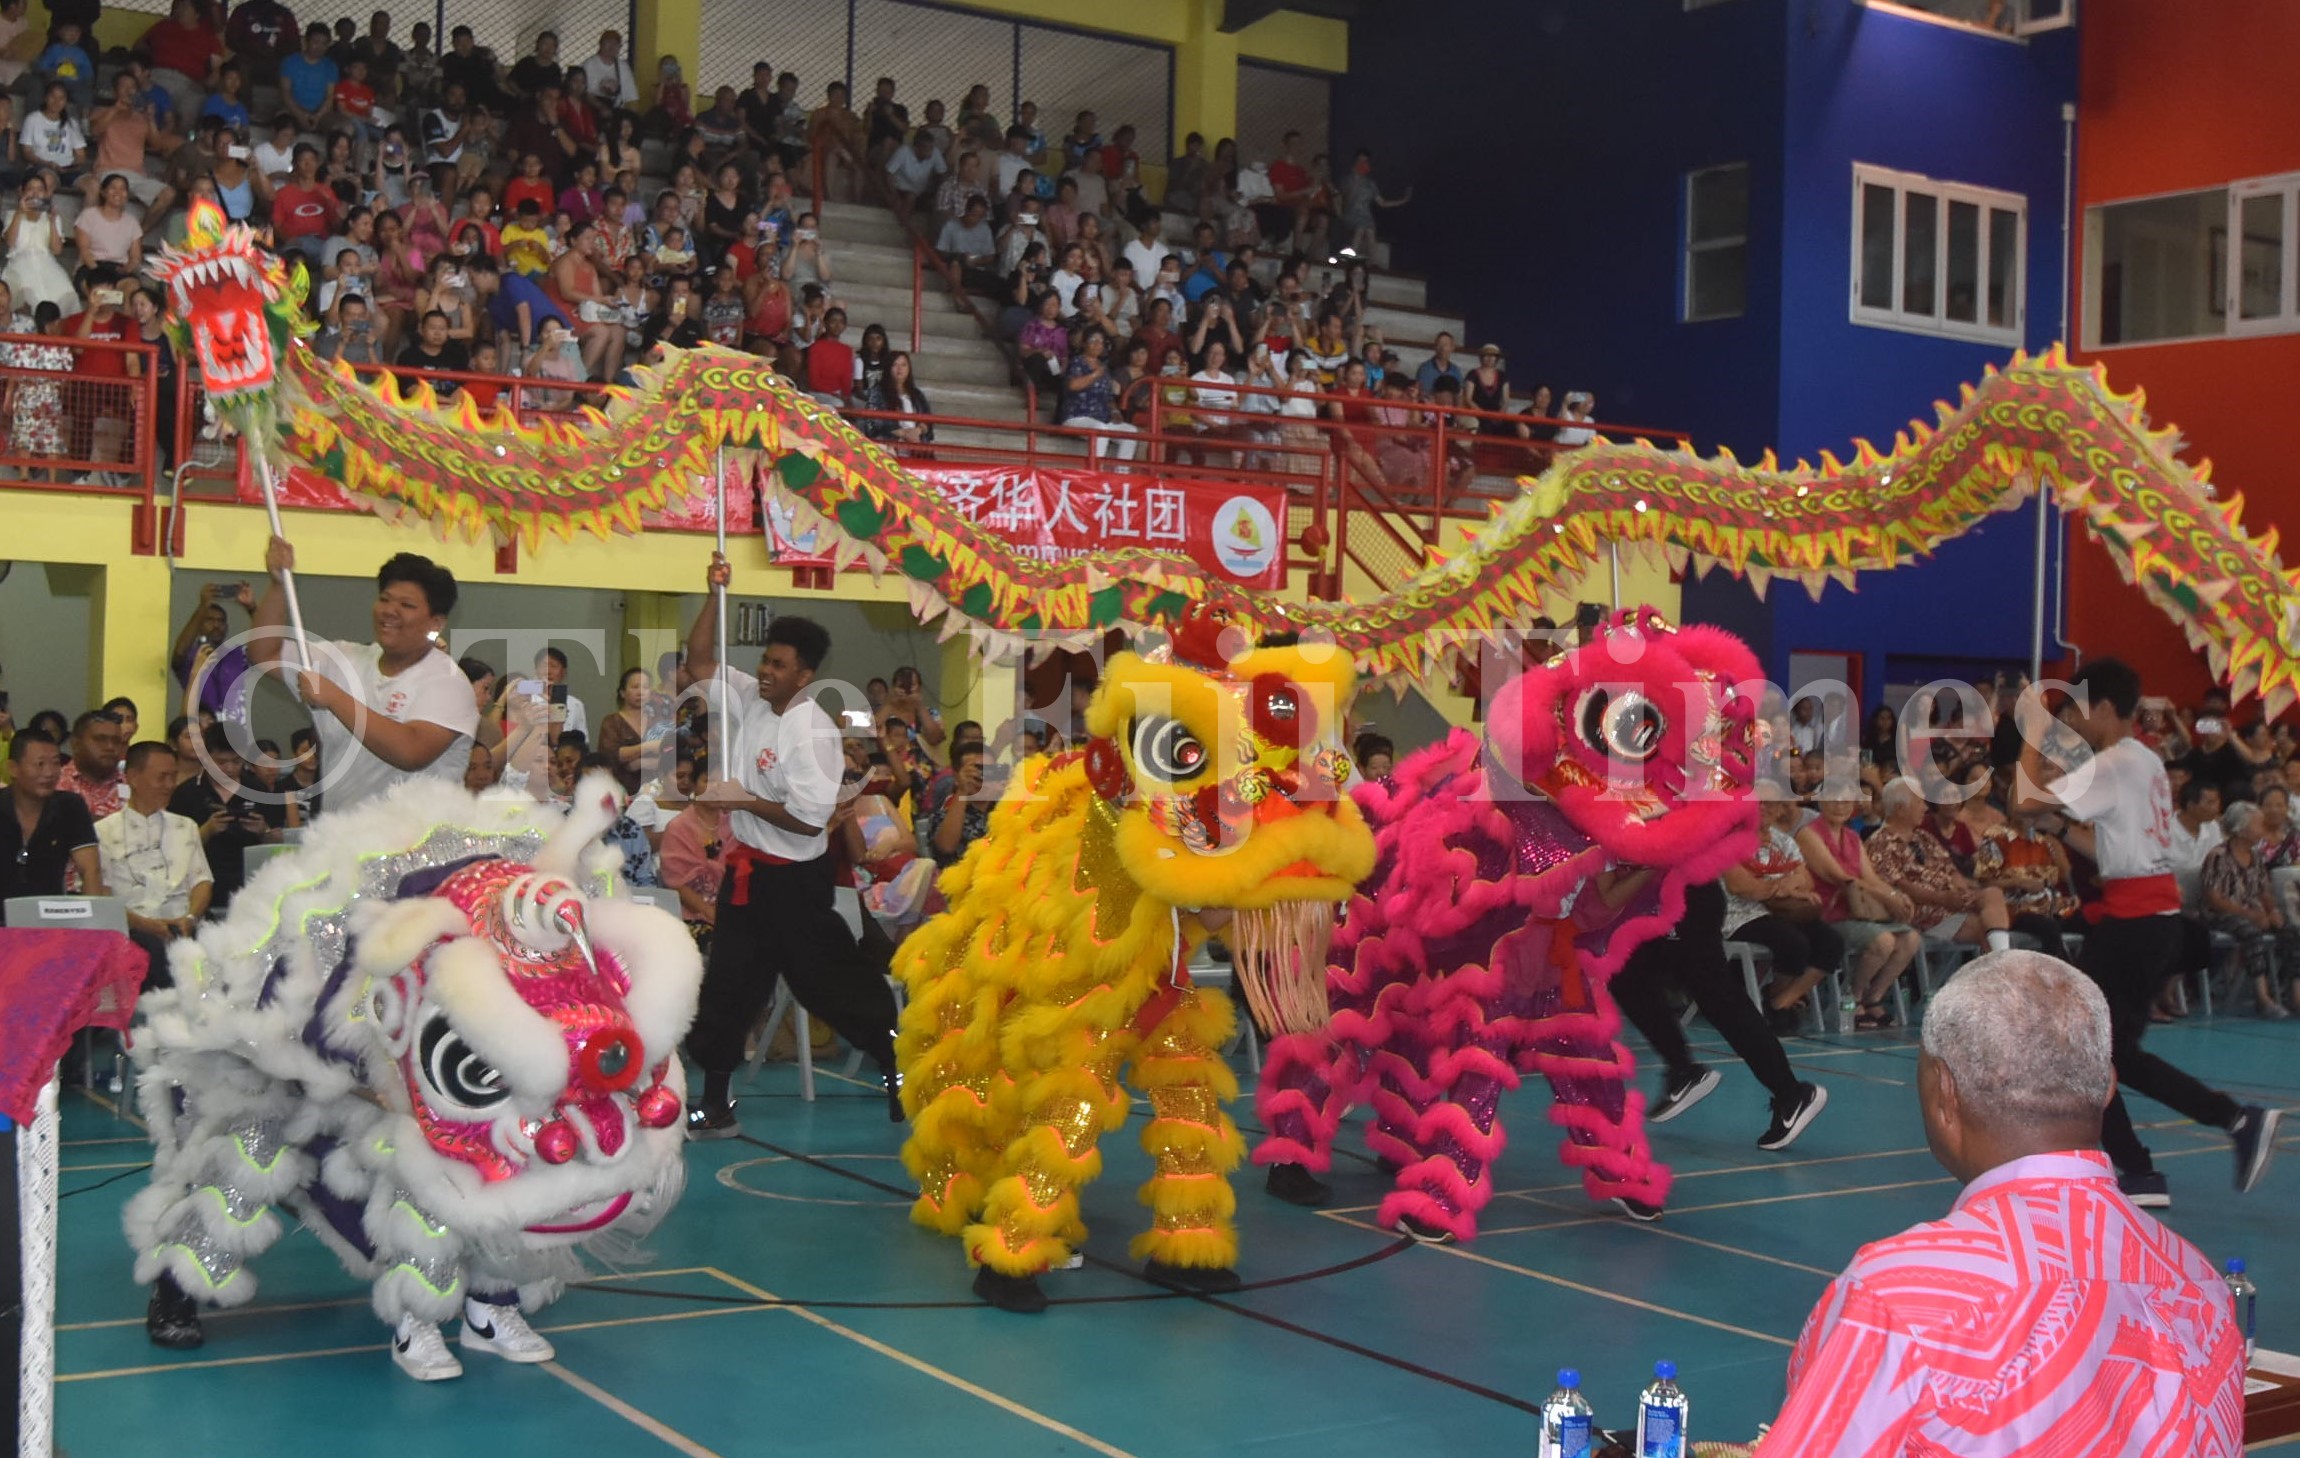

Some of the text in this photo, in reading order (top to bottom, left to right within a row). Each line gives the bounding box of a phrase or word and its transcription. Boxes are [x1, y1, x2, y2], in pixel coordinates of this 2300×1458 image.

[920, 473, 1186, 542] 济华人社团
